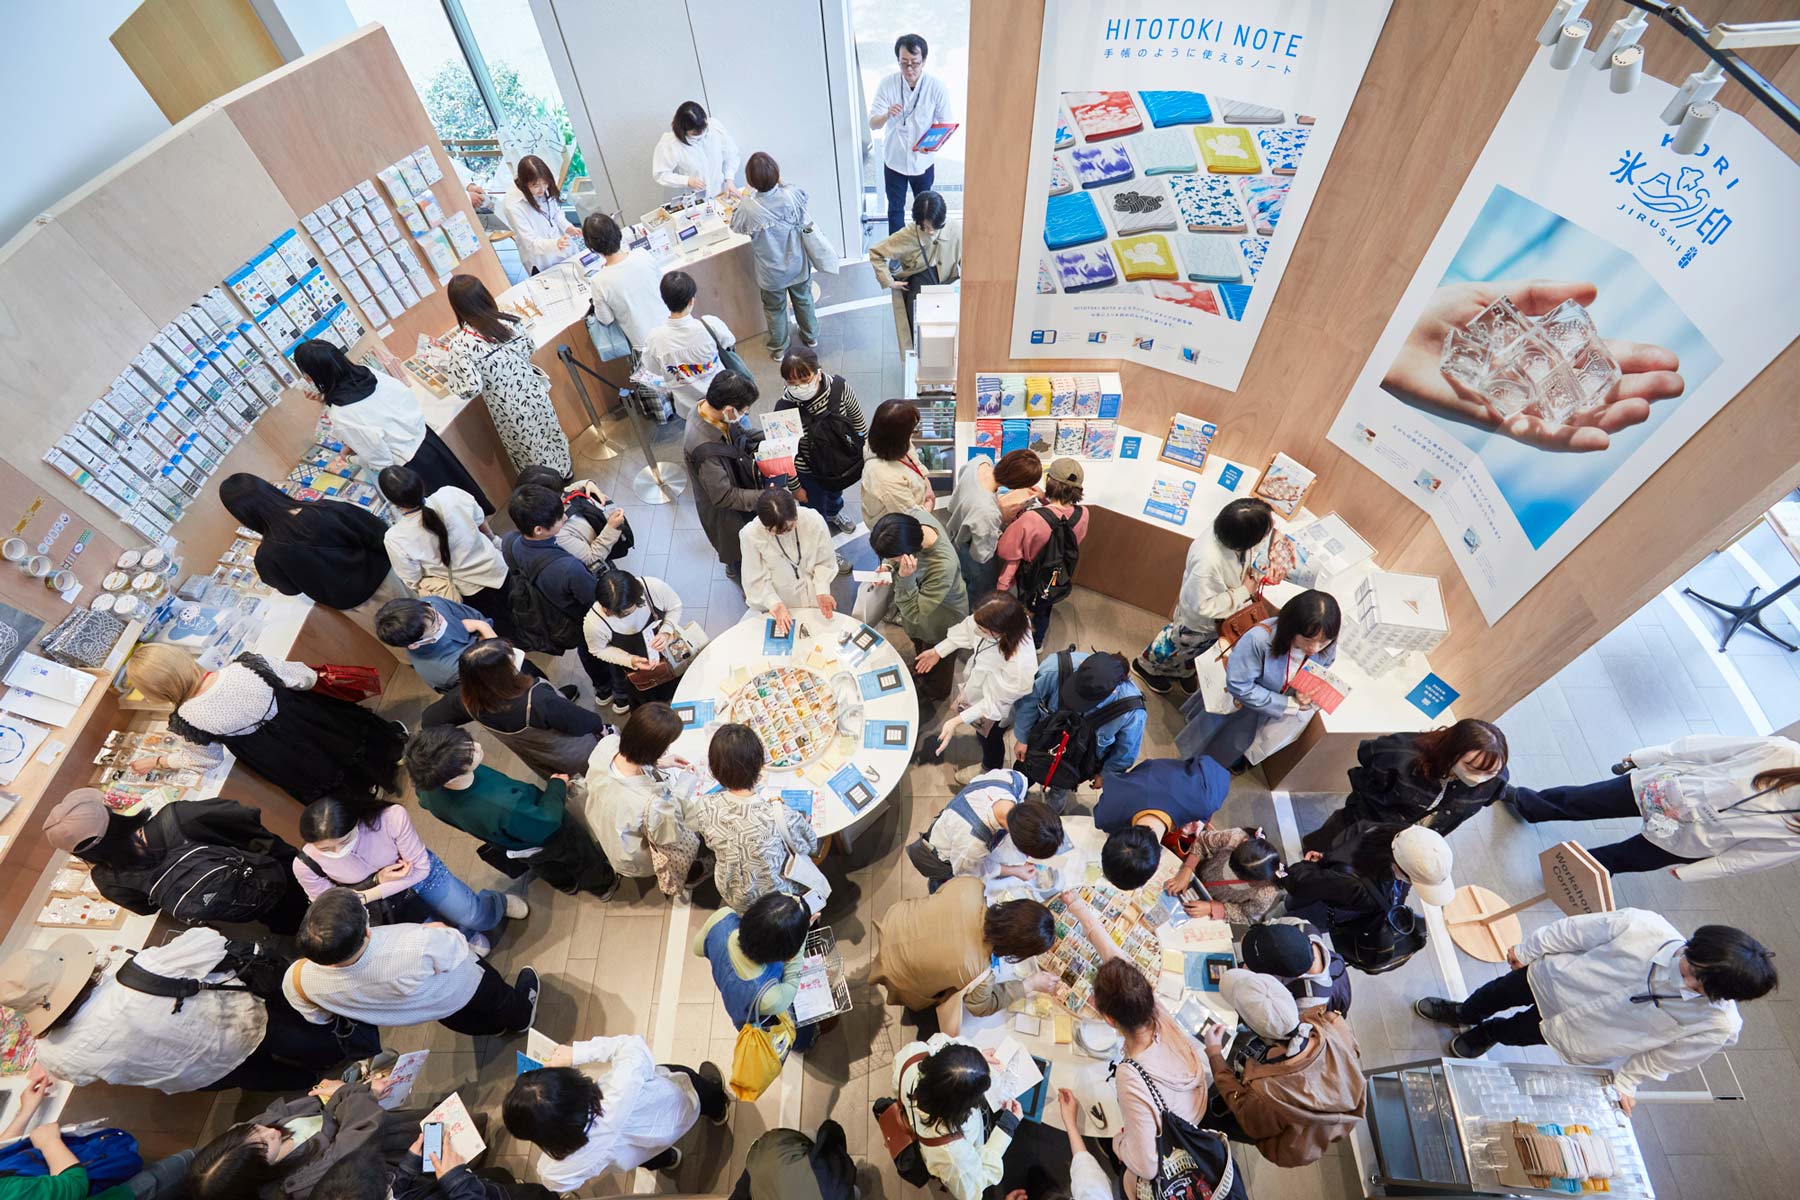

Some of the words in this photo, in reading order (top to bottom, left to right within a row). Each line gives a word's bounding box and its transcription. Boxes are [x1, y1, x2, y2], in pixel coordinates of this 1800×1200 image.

[1106, 18, 1223, 42] HITOTOKI
[1233, 24, 1303, 58] NOTE
[1103, 47, 1292, 75] 手帳のように使えるノート
[1609, 150, 1647, 185] 氷
[1696, 207, 1732, 245] 印
[1616, 204, 1682, 252] JIRUSHI
[1553, 865, 1579, 908] Corner
[1555, 852, 1593, 914] Workshop
